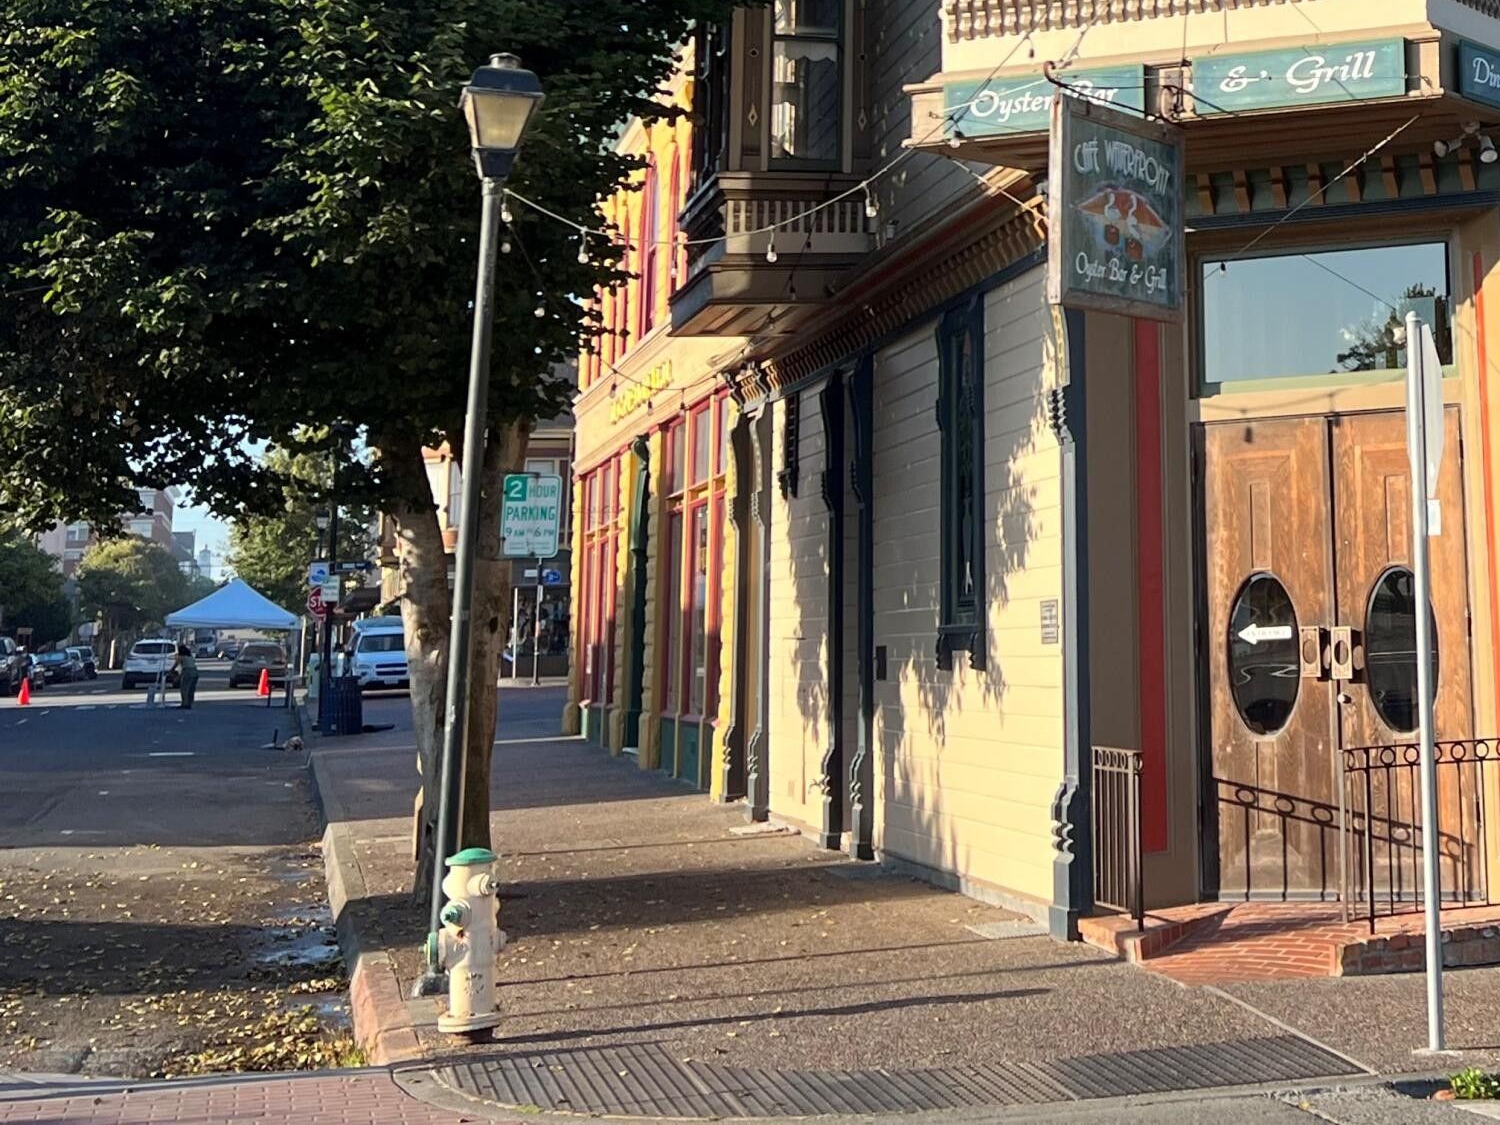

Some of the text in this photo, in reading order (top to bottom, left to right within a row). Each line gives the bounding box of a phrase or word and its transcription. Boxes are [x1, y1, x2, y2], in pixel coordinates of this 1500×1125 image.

[1286, 51, 1376, 93] Grill
[970, 89, 1055, 122] Oyster
[1104, 140, 1170, 196] WATERFRONT
[1076, 251, 1167, 294] Oyster Bar & Grill
[510, 480, 557, 498] 2 HOUR
[506, 506, 556, 521] PARKING
